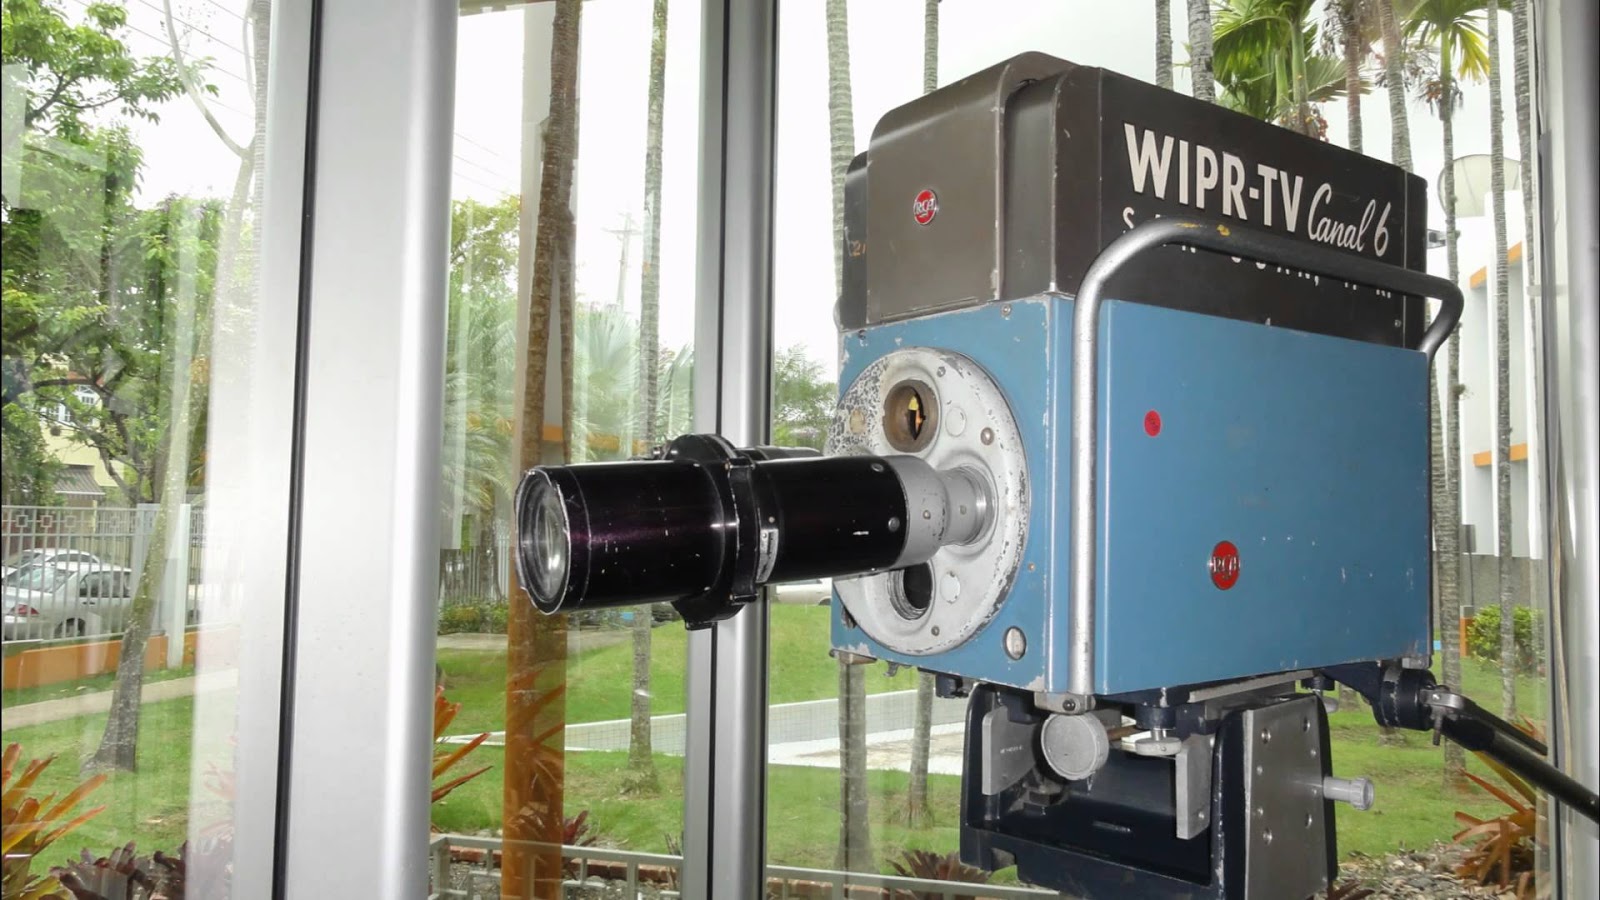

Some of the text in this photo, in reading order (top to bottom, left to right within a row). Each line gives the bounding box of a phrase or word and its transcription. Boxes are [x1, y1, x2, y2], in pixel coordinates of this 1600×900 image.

[1124, 123, 1303, 232] WIPR-TV
[1307, 183, 1376, 252] Canal
[1374, 202, 1392, 257] 6
[913, 199, 936, 217] RCA
[1211, 555, 1240, 580] RCA
